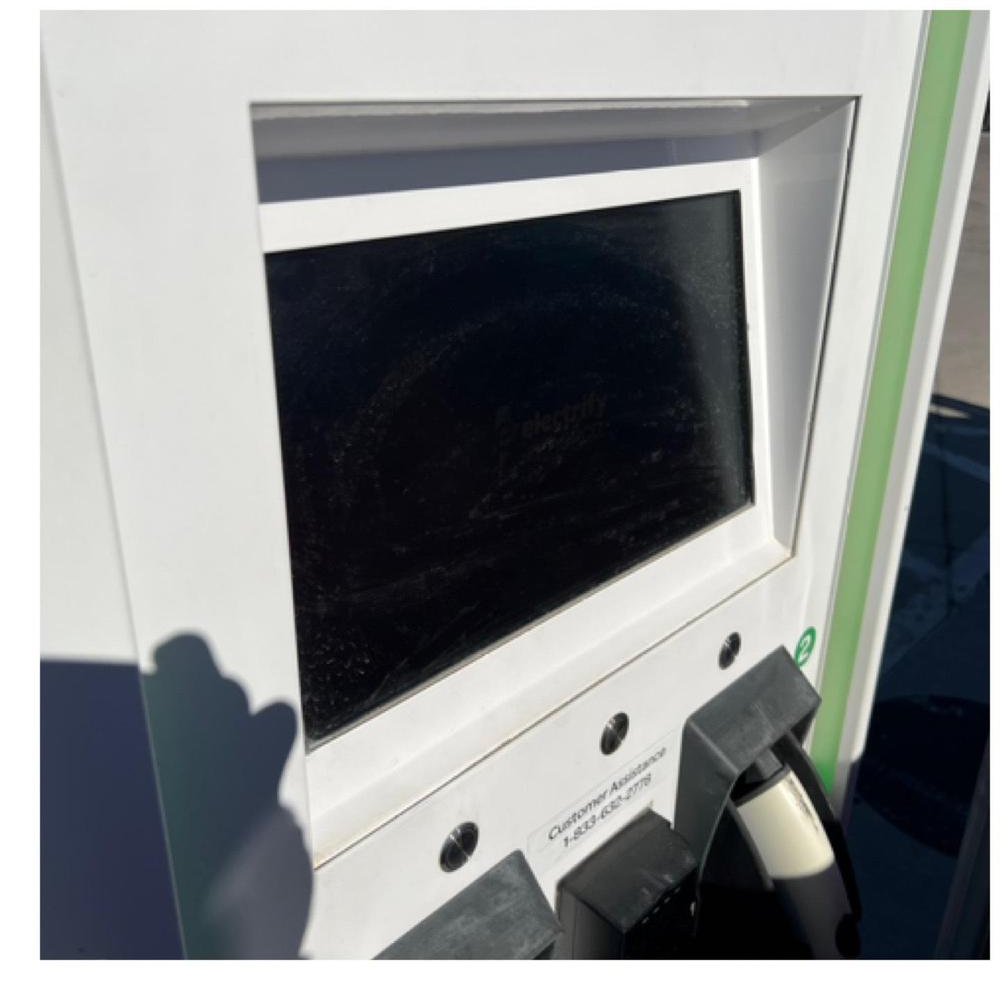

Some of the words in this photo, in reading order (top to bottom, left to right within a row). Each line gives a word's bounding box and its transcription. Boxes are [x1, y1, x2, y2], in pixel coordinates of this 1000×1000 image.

[797, 634, 812, 665] 2
[548, 789, 609, 840] Customer
[609, 747, 667, 795] Assistance
